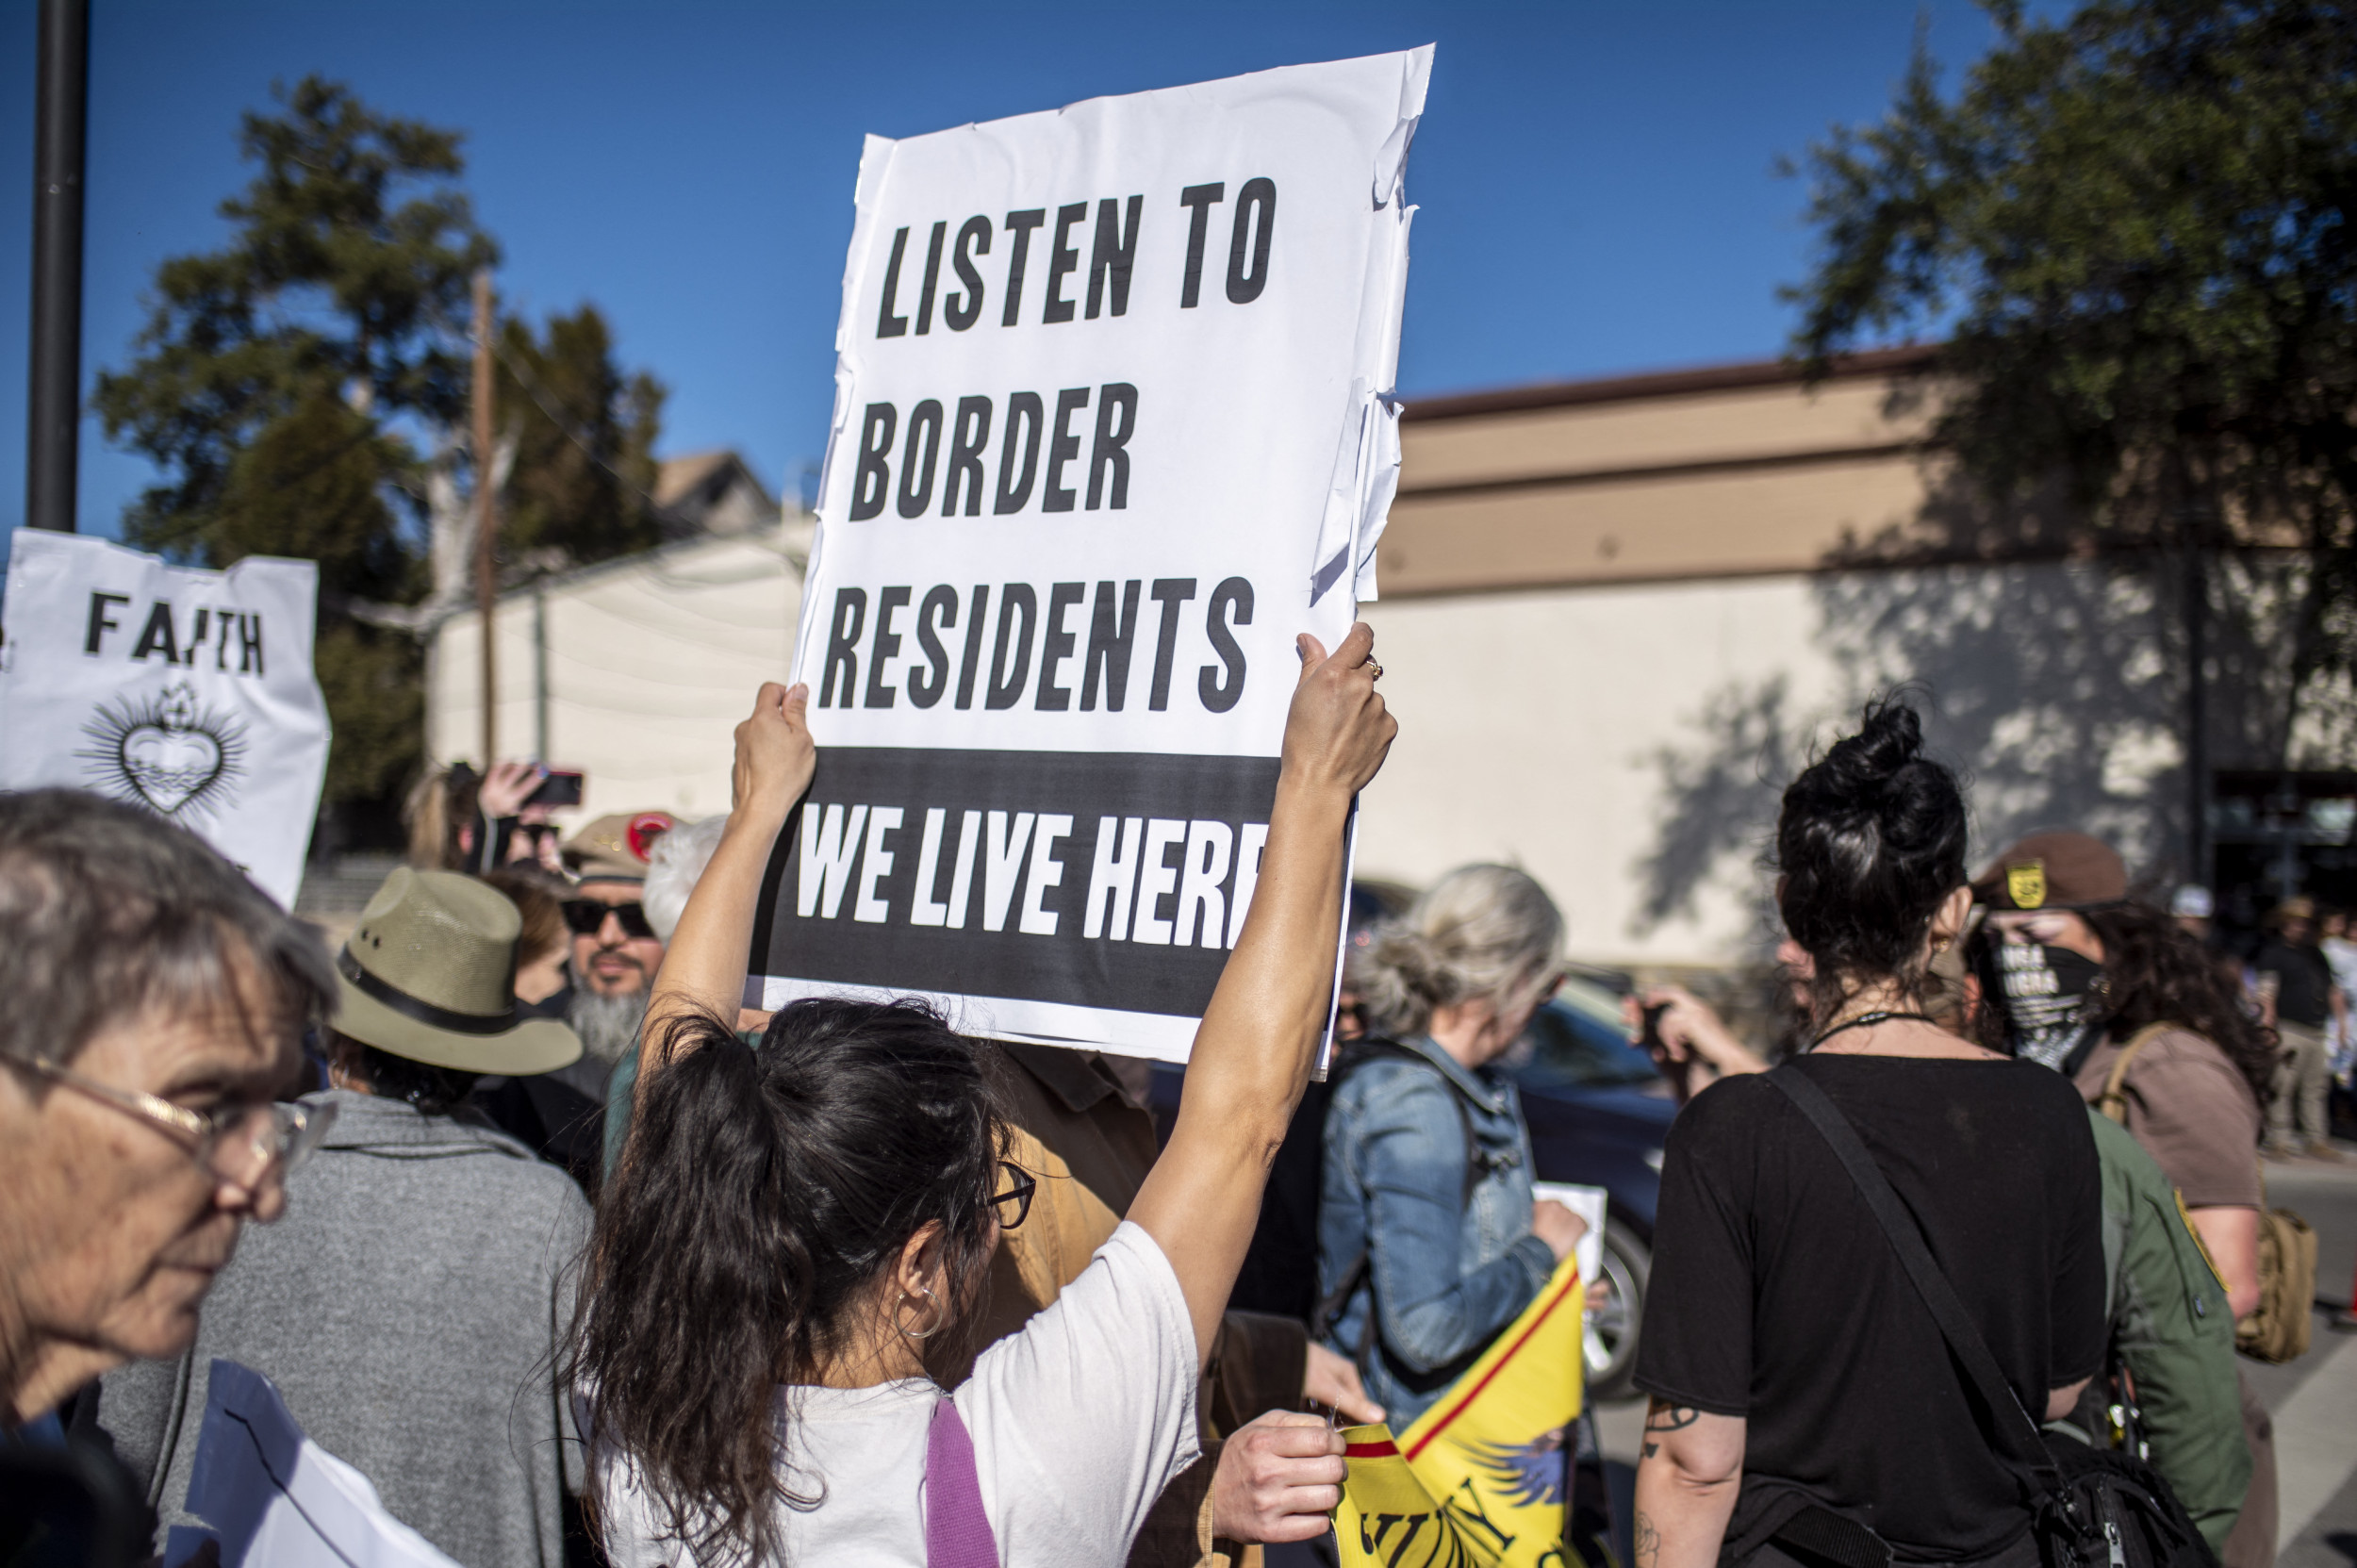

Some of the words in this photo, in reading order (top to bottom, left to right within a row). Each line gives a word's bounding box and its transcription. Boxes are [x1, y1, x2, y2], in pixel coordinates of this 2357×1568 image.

[876, 193, 1144, 339] LISTEN
[1179, 176, 1277, 309] TO
[849, 382, 1139, 522] BORDER
[85, 592, 264, 675] FAITH
[817, 576, 1255, 714] RESIDENTS
[797, 802, 904, 924] WE
[910, 807, 1074, 935] LIVE
